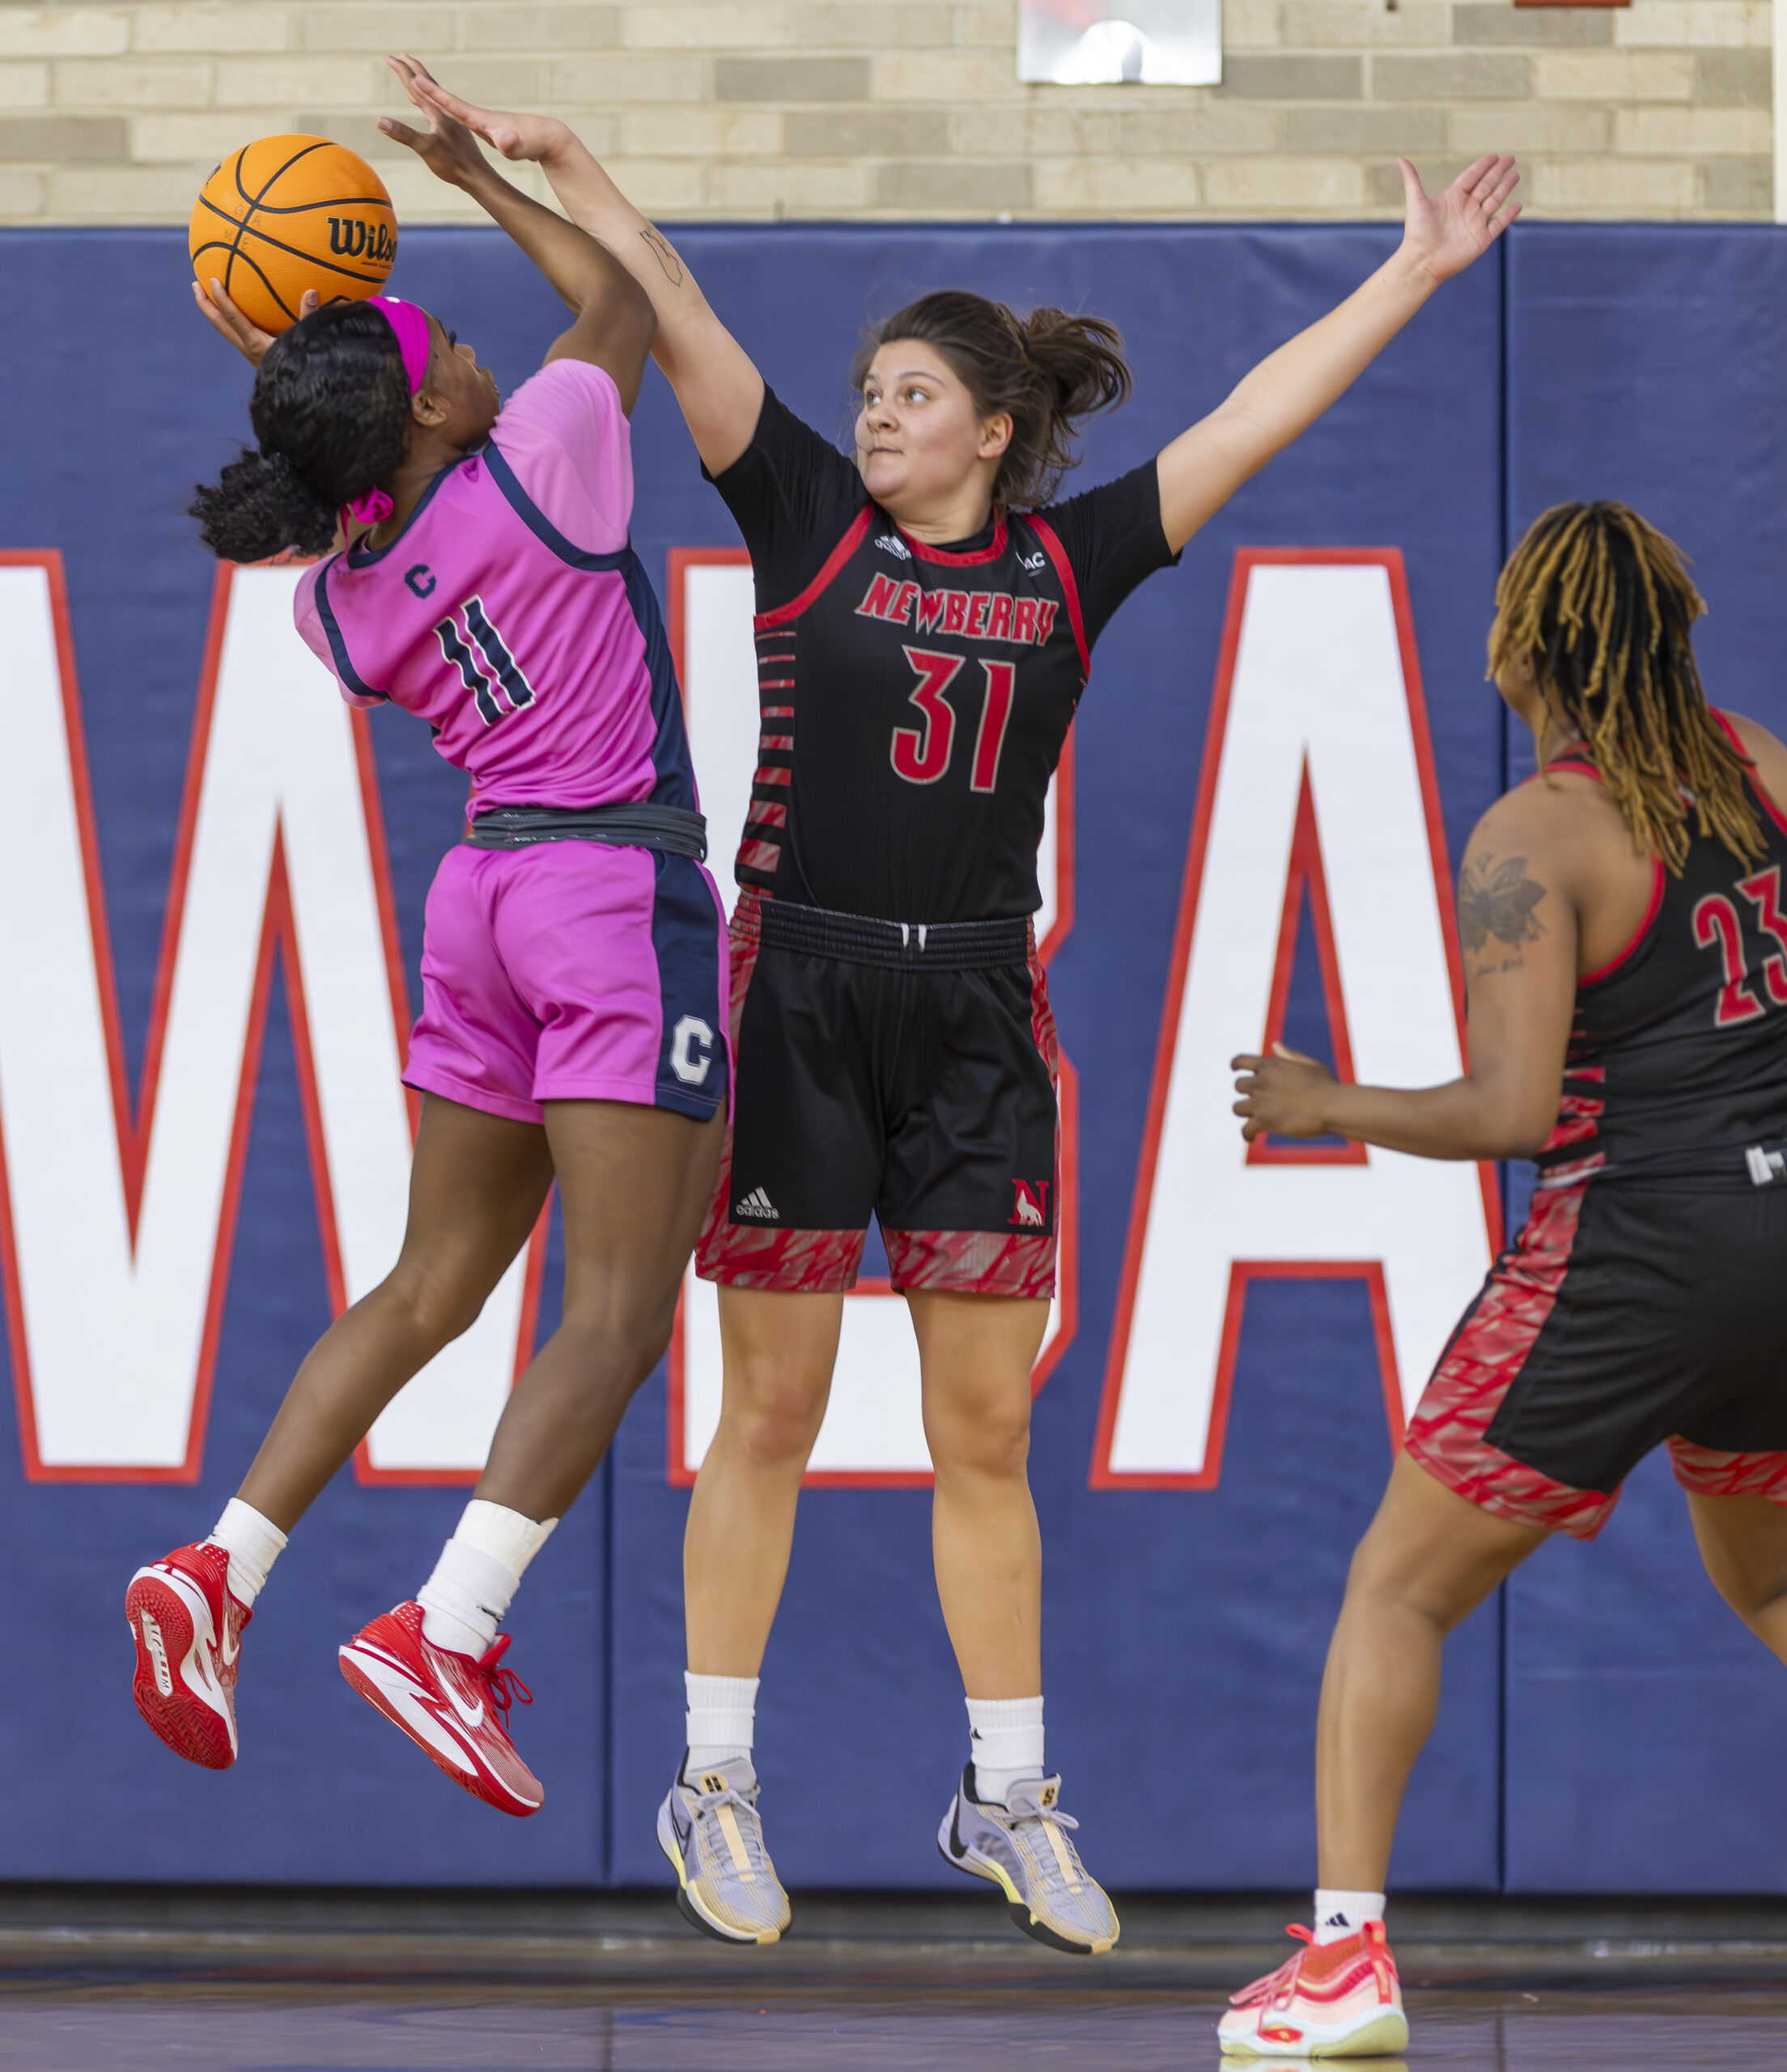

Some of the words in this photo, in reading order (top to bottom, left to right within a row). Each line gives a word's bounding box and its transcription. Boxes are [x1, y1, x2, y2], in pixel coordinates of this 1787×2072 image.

[404, 563, 437, 600] C
[1015, 550, 1046, 570] AC
[854, 571, 1059, 647] NEWBERRY
[432, 593, 536, 727] 11
[890, 644, 1016, 793] 31
[1691, 864, 1787, 1026] 23
[669, 1014, 714, 1085] C
[736, 1204, 779, 1220] adidas
[1007, 1178, 1050, 1226] N
